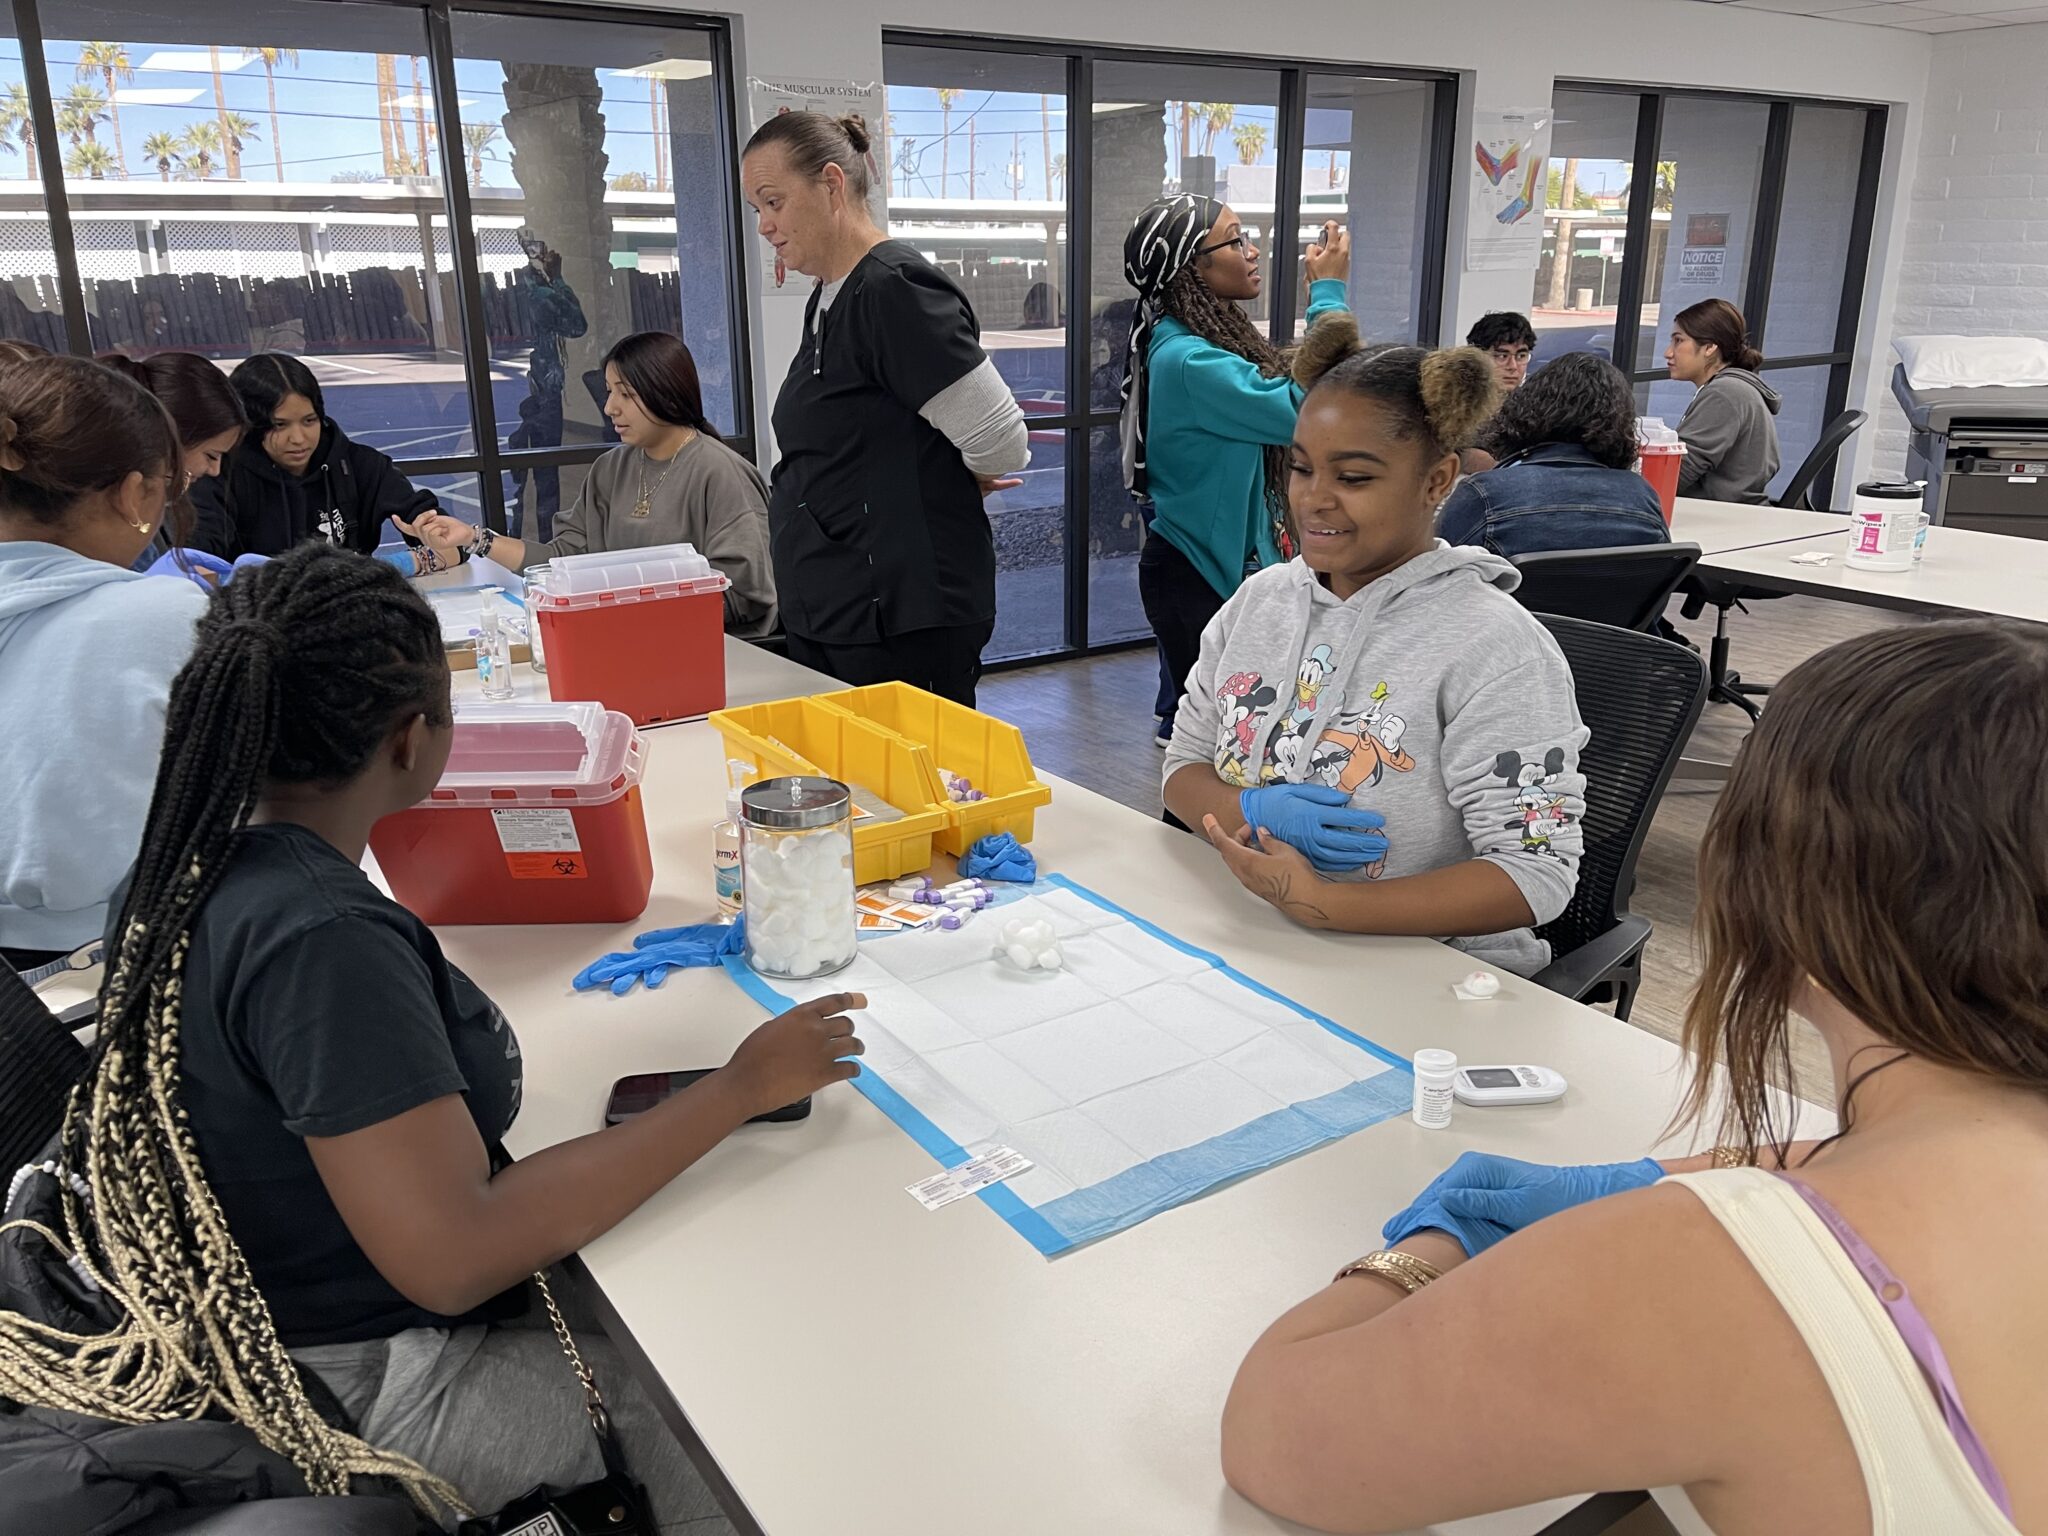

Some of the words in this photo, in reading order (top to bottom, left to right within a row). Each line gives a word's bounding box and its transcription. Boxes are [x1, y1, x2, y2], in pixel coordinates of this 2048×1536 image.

[763, 83, 782, 93] THE
[784, 84, 836, 95] MUSCULAR
[837, 87, 872, 97] SYSTEM
[1684, 252, 1722, 263] NOTICE
